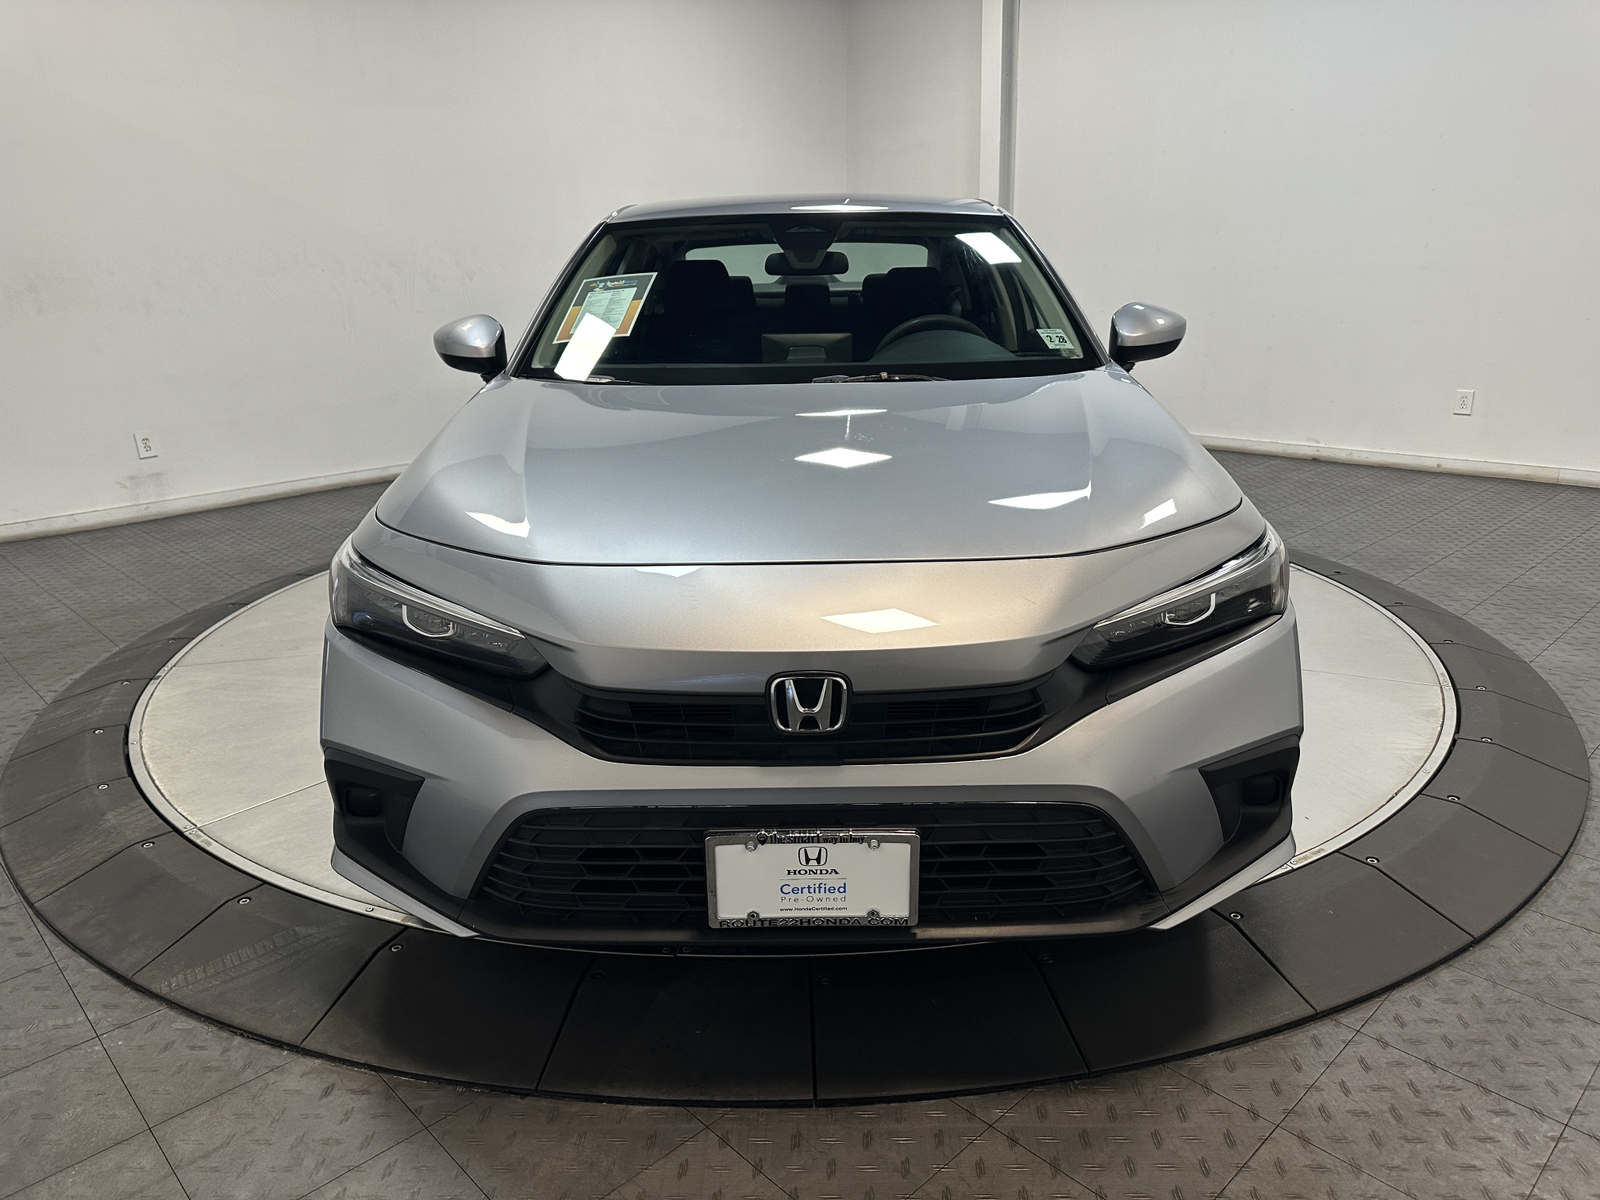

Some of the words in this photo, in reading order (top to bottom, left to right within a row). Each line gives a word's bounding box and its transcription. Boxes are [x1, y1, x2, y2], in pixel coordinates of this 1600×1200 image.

[769, 833, 786, 844] the
[787, 833, 821, 844] smart
[822, 835, 838, 845] way
[839, 834, 848, 844] to
[849, 833, 865, 845] buy
[786, 868, 840, 876] HONDA
[779, 882, 847, 895] Certified
[780, 895, 847, 903] Pre-Owned
